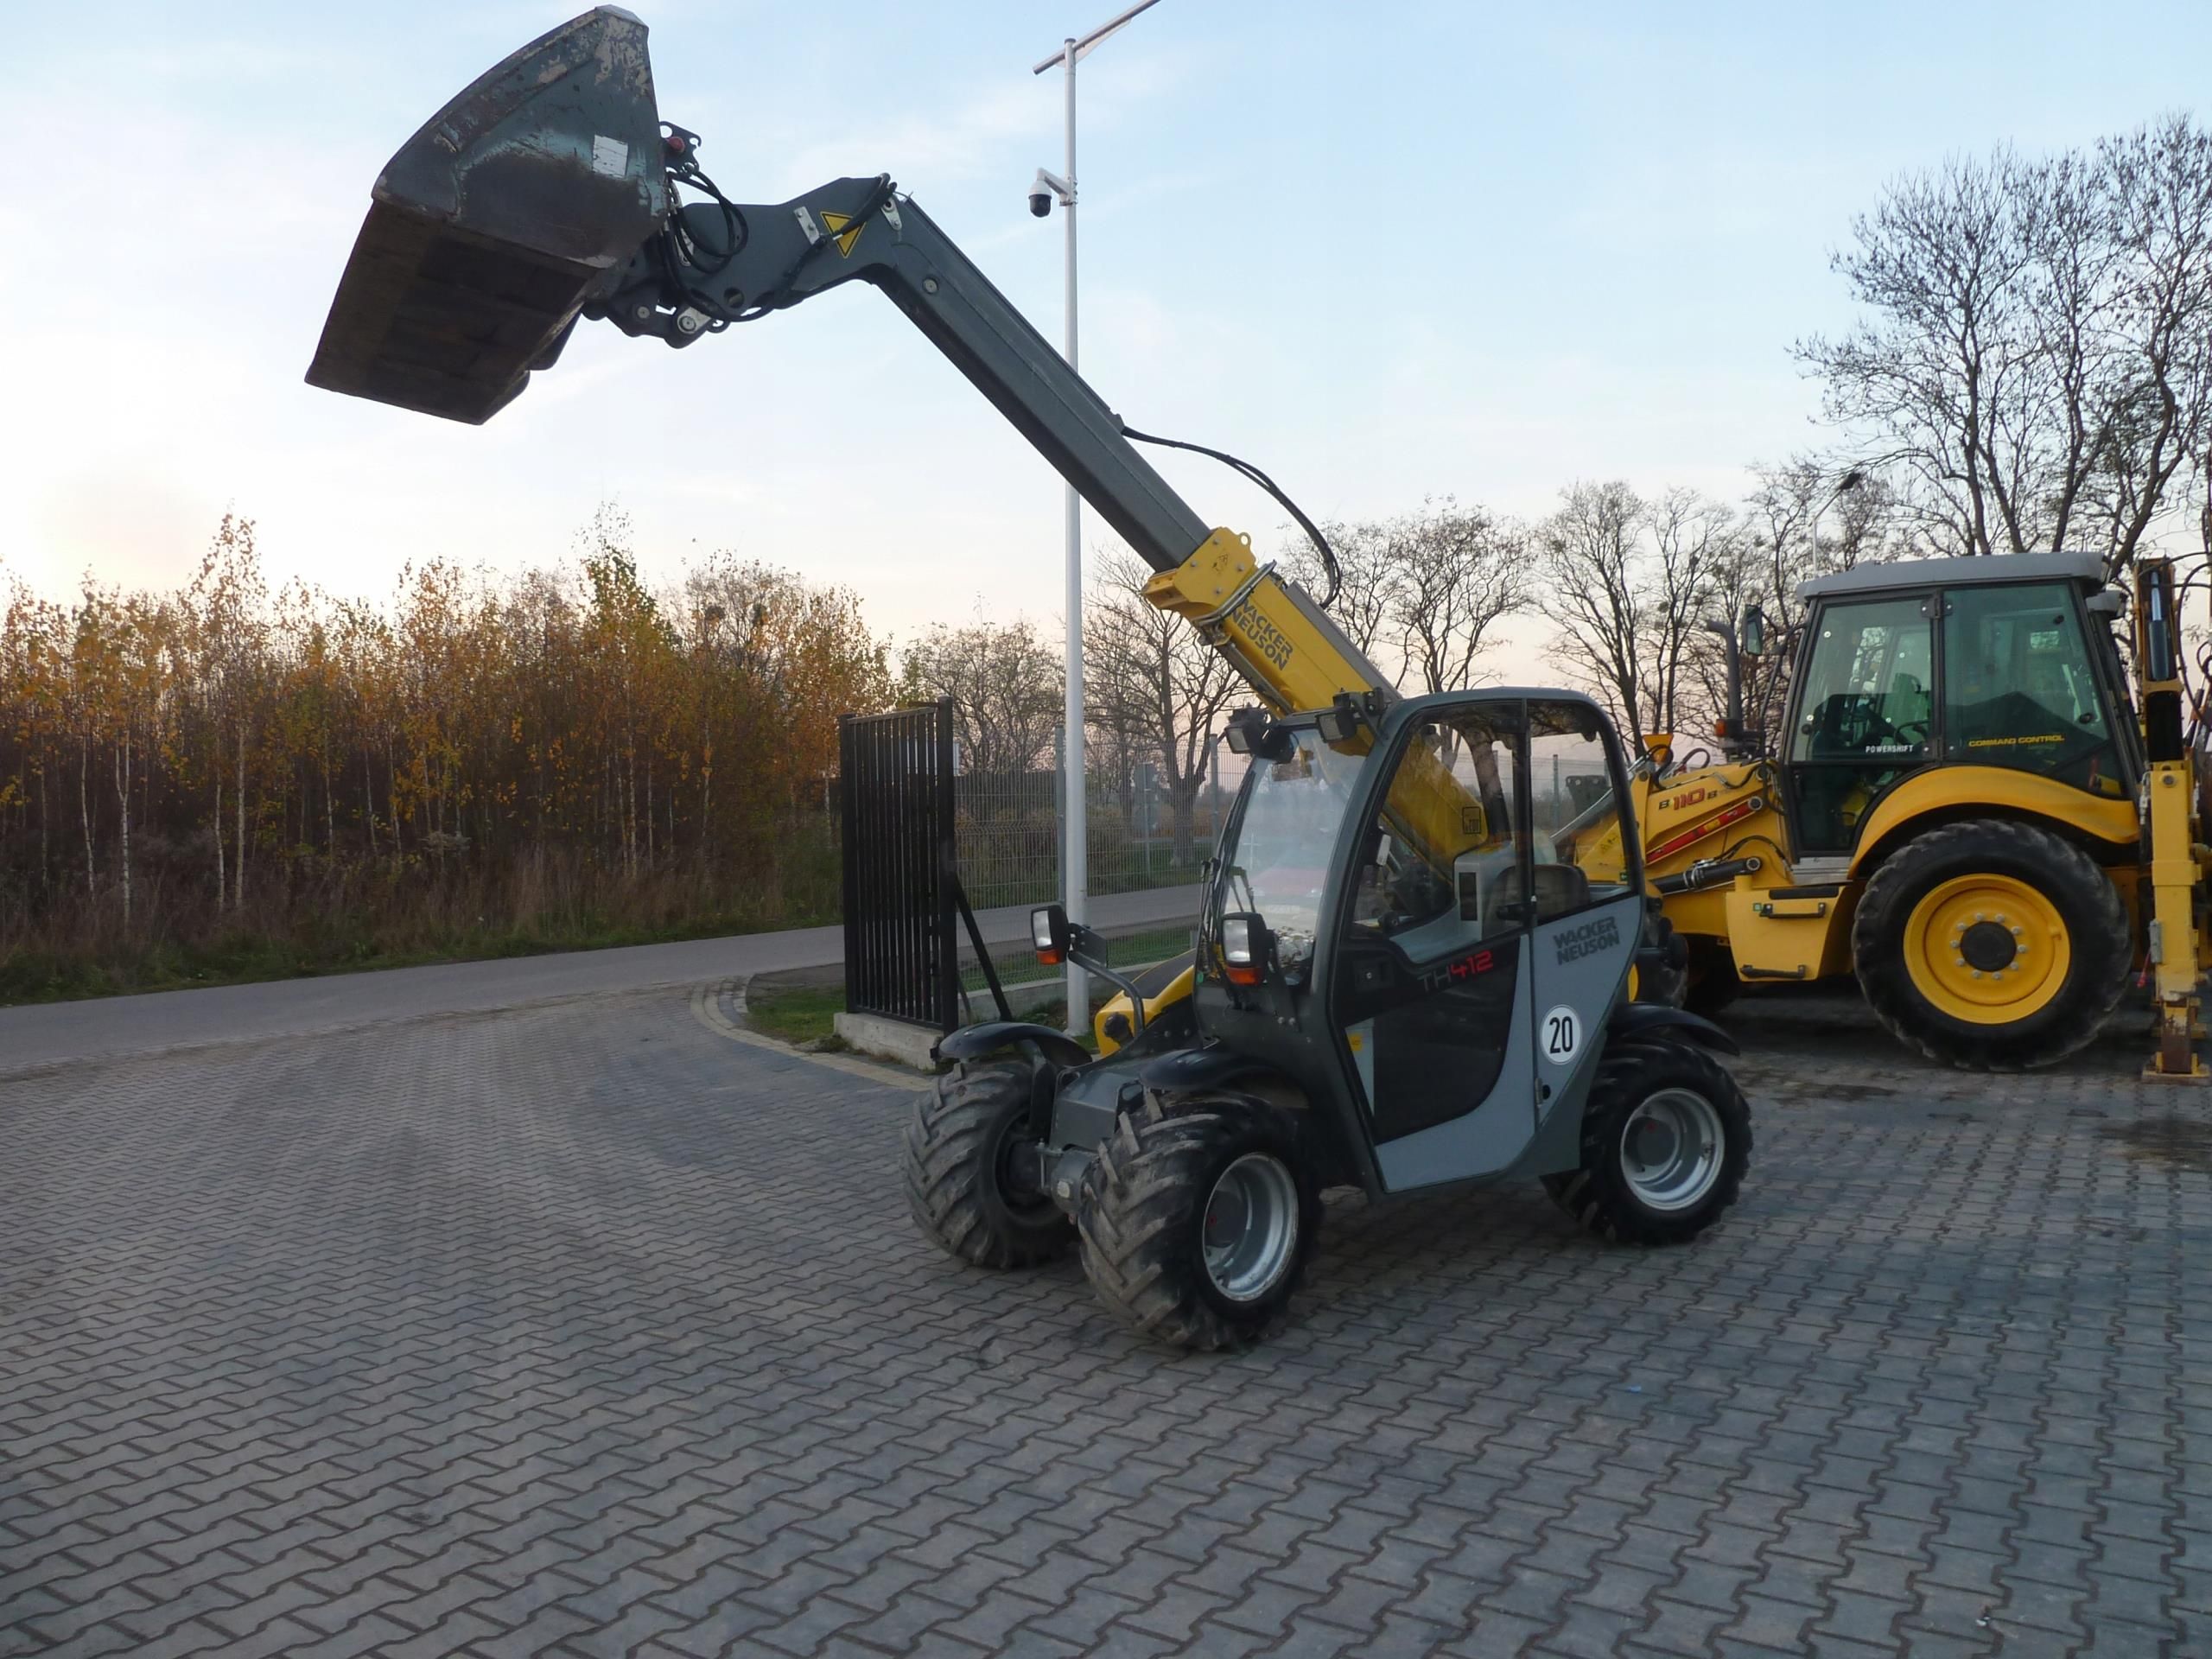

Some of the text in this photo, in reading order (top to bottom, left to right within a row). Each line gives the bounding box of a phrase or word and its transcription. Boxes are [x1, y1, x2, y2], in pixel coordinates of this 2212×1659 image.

[1865, 745, 1913, 753] POWERSHIFT
[1968, 734, 2065, 747] COMMAND CONTROL
[1553, 916, 1618, 949] WACKER
[1557, 931, 1620, 965] NEUSON
[1417, 950, 1493, 992] TH412
[1549, 1015, 1573, 1054] 20
